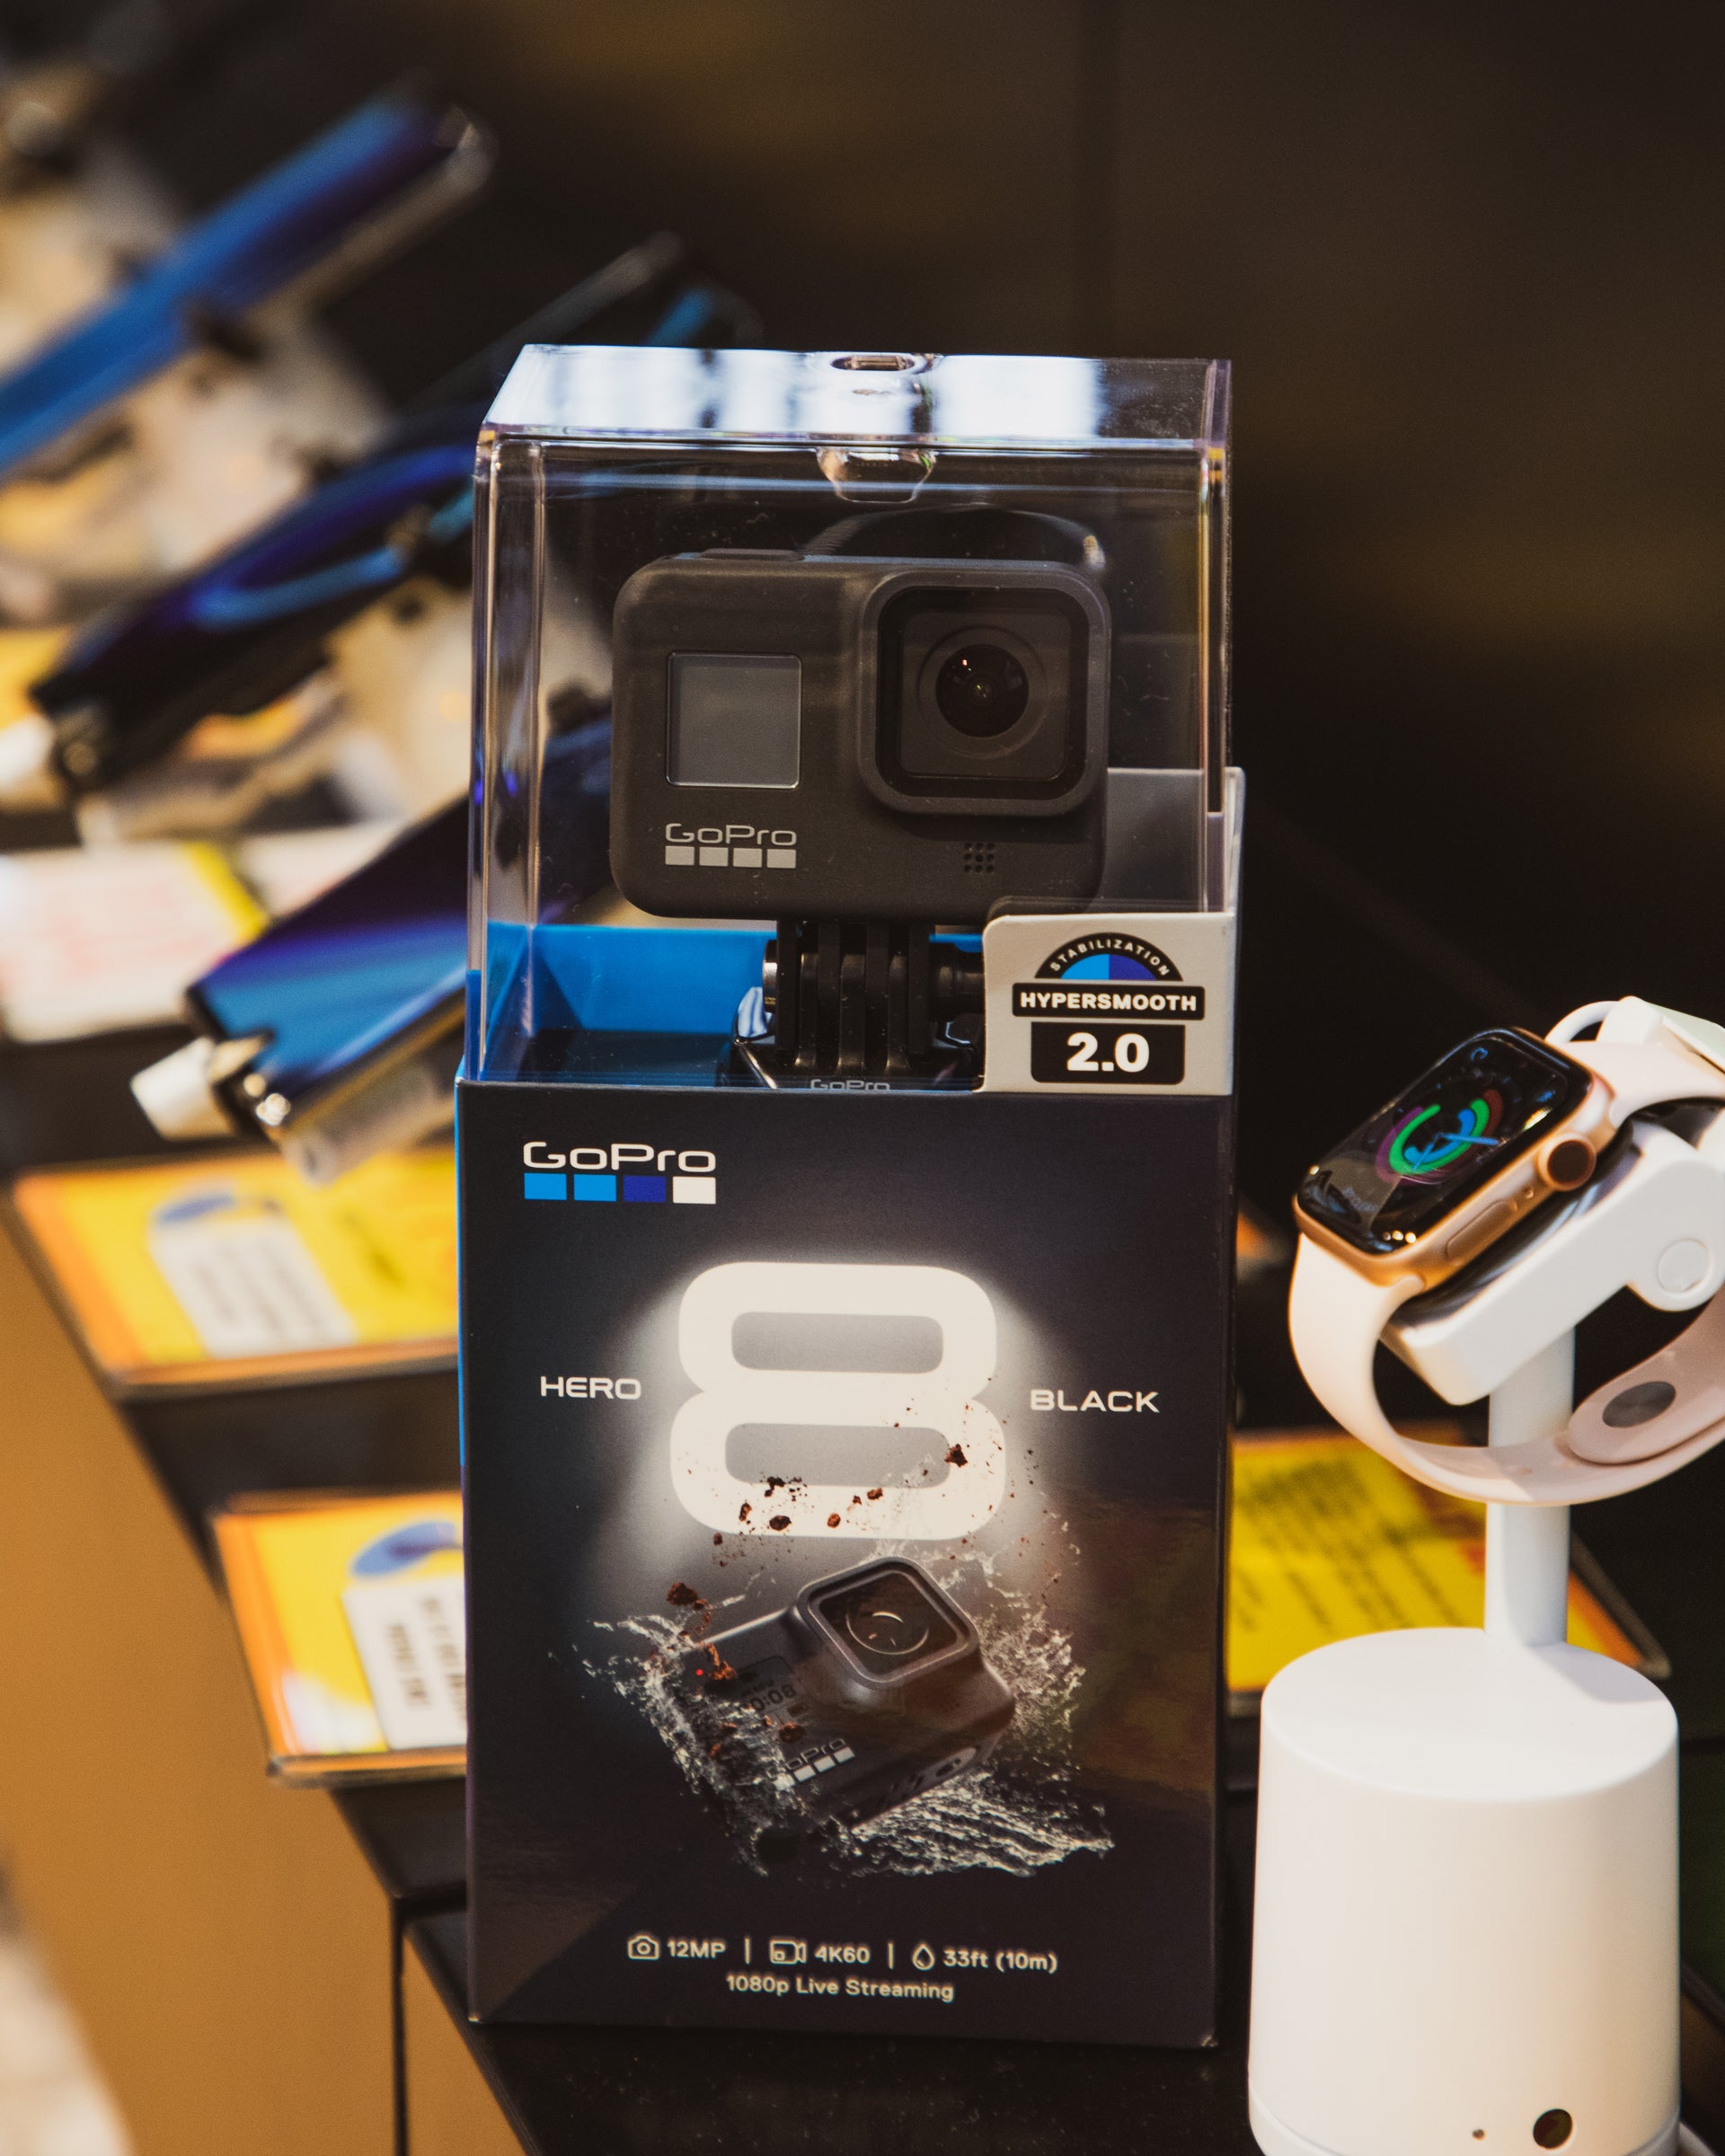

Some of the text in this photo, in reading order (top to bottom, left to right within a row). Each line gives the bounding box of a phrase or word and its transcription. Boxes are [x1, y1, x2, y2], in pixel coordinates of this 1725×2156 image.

[665, 823, 797, 846] GoPro
[1049, 939, 1170, 976] STABILIZATION
[1020, 991, 1197, 1012] HYPERSMOOTH
[1066, 1031, 1150, 1073] 2.0
[810, 1079, 890, 1090] GoPro
[523, 1141, 716, 1172] GoPro
[540, 1262, 1160, 1540] HERO 8 BLACK
[668, 1939, 1058, 1975] 12MP 4K60 33ft (10m)
[726, 1975, 954, 2003] 1080p Live Streaming
